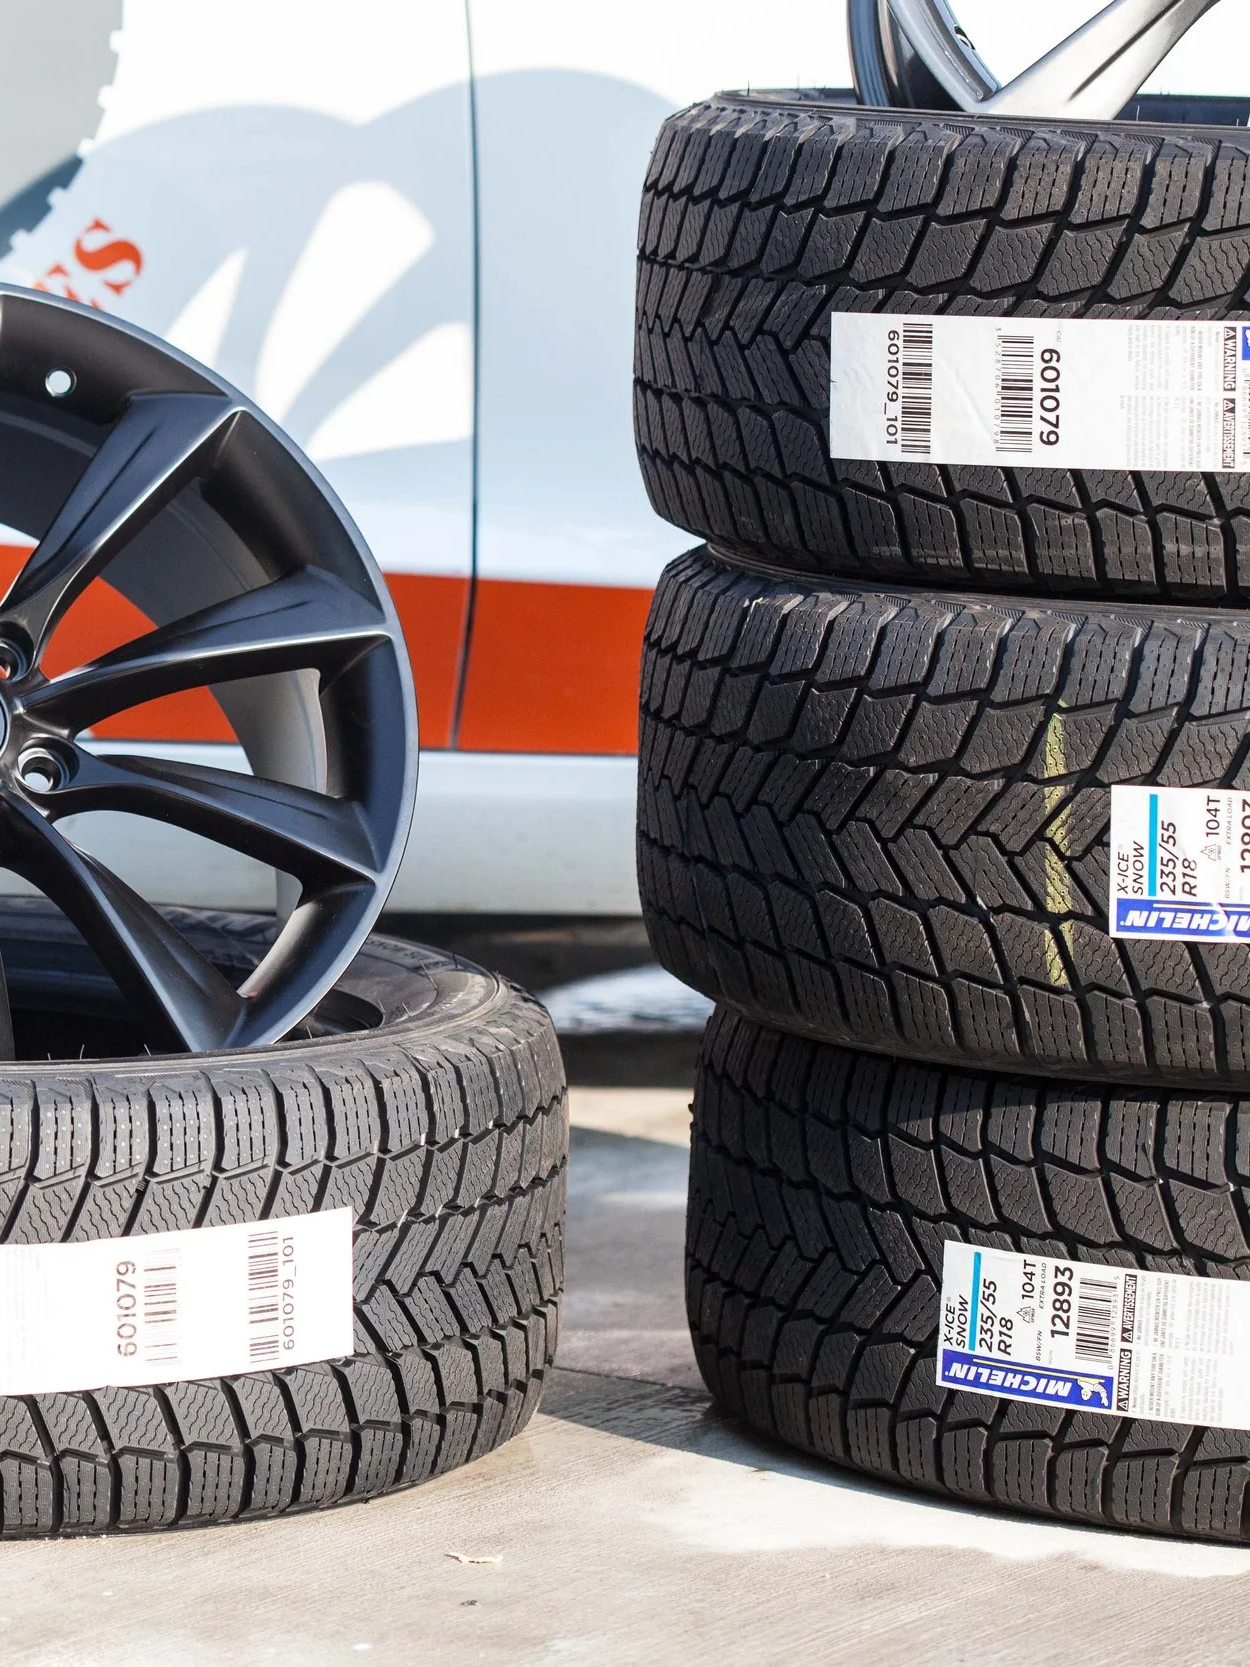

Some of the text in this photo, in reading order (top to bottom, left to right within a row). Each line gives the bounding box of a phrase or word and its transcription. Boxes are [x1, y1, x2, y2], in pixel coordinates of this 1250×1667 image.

[883, 329, 900, 445] 601079_101
[1224, 339, 1236, 390] WARNING
[1039, 348, 1061, 446] 601079
[1223, 412, 1235, 467] AVERTISSEMENT
[1206, 795, 1221, 838] 104T
[1117, 852, 1129, 894] X-ICE
[1132, 841, 1145, 896] SNOW
[1158, 820, 1180, 896] 235/55
[1182, 858, 1197, 897] R18
[282, 1236, 297, 1351] 601079_101
[1021, 1259, 1036, 1300] 104T
[1050, 1265, 1074, 1339] 12893
[1123, 1274, 1138, 1330] AVERTISSEMENT
[115, 1260, 138, 1357] 601079
[943, 1303, 956, 1346] X-ICE
[956, 1294, 969, 1349] SNOW
[978, 1278, 997, 1353] 235/55
[997, 1317, 1013, 1356] R18
[948, 1362, 1073, 1397] MICHELIN
[1118, 1350, 1132, 1399] WARNING
